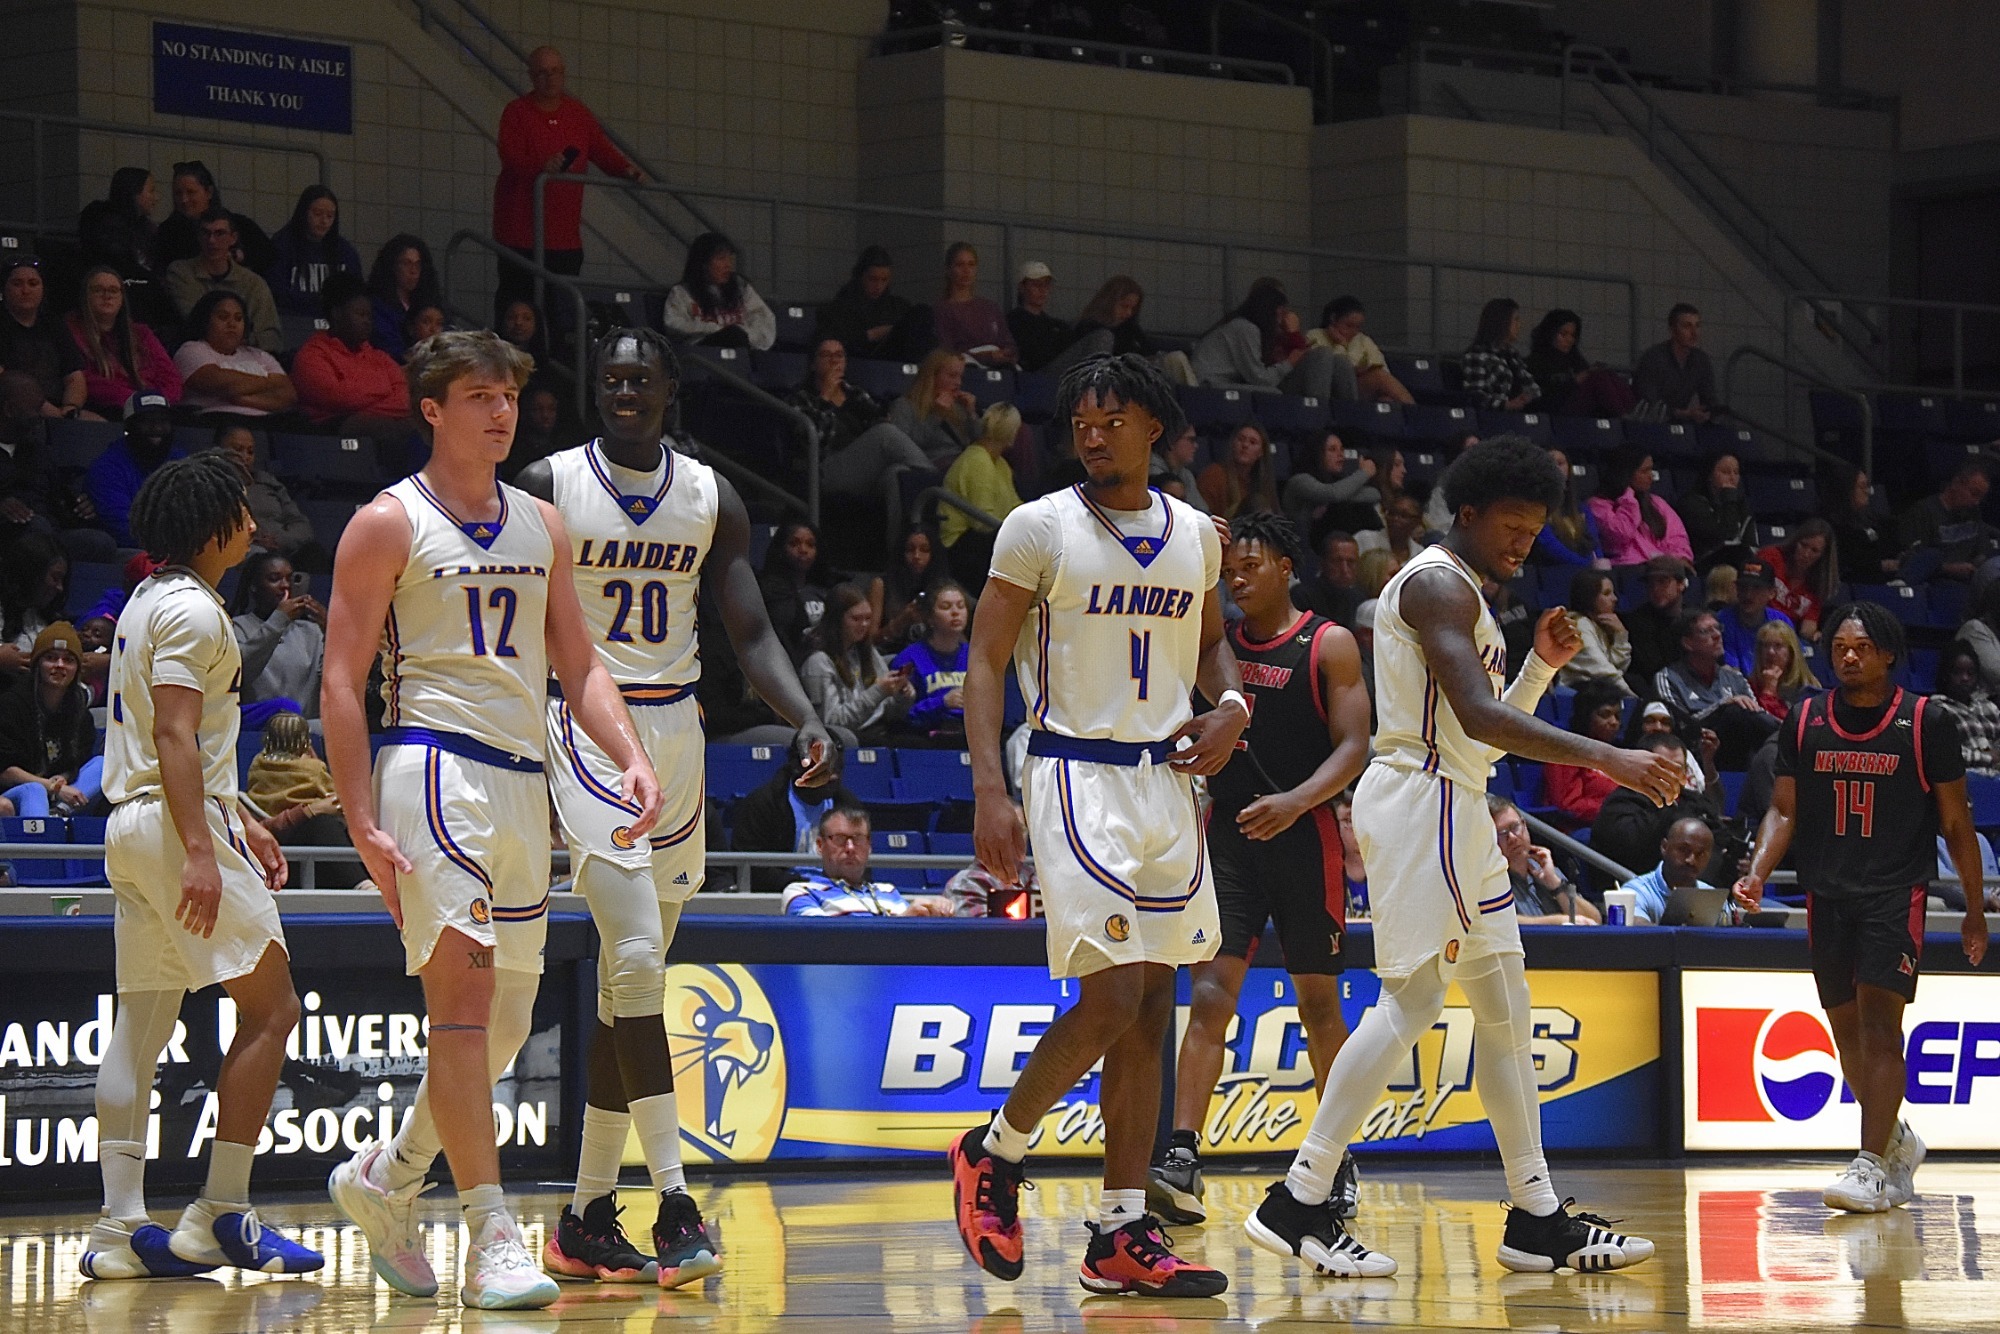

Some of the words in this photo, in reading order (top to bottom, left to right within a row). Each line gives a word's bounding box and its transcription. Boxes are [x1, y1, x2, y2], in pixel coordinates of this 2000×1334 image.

[161, 40, 187, 56] NO
[190, 44, 274, 68] STANDING
[279, 54, 295, 71] IN
[299, 58, 345, 77] AISLE
[206, 85, 265, 106] THANK
[269, 93, 304, 110] YOU
[574, 538, 698, 573] LANDER
[602, 578, 669, 644] 20
[1082, 583, 1194, 620] LANDER
[460, 585, 520, 658] 12
[1129, 627, 1152, 702] 4
[1237, 659, 1293, 689] BERRY
[755, 747, 766, 759] 10
[1814, 750, 1900, 776] NEWBERRY
[30, 820, 38, 832] 3
[1833, 780, 1875, 837] 14
